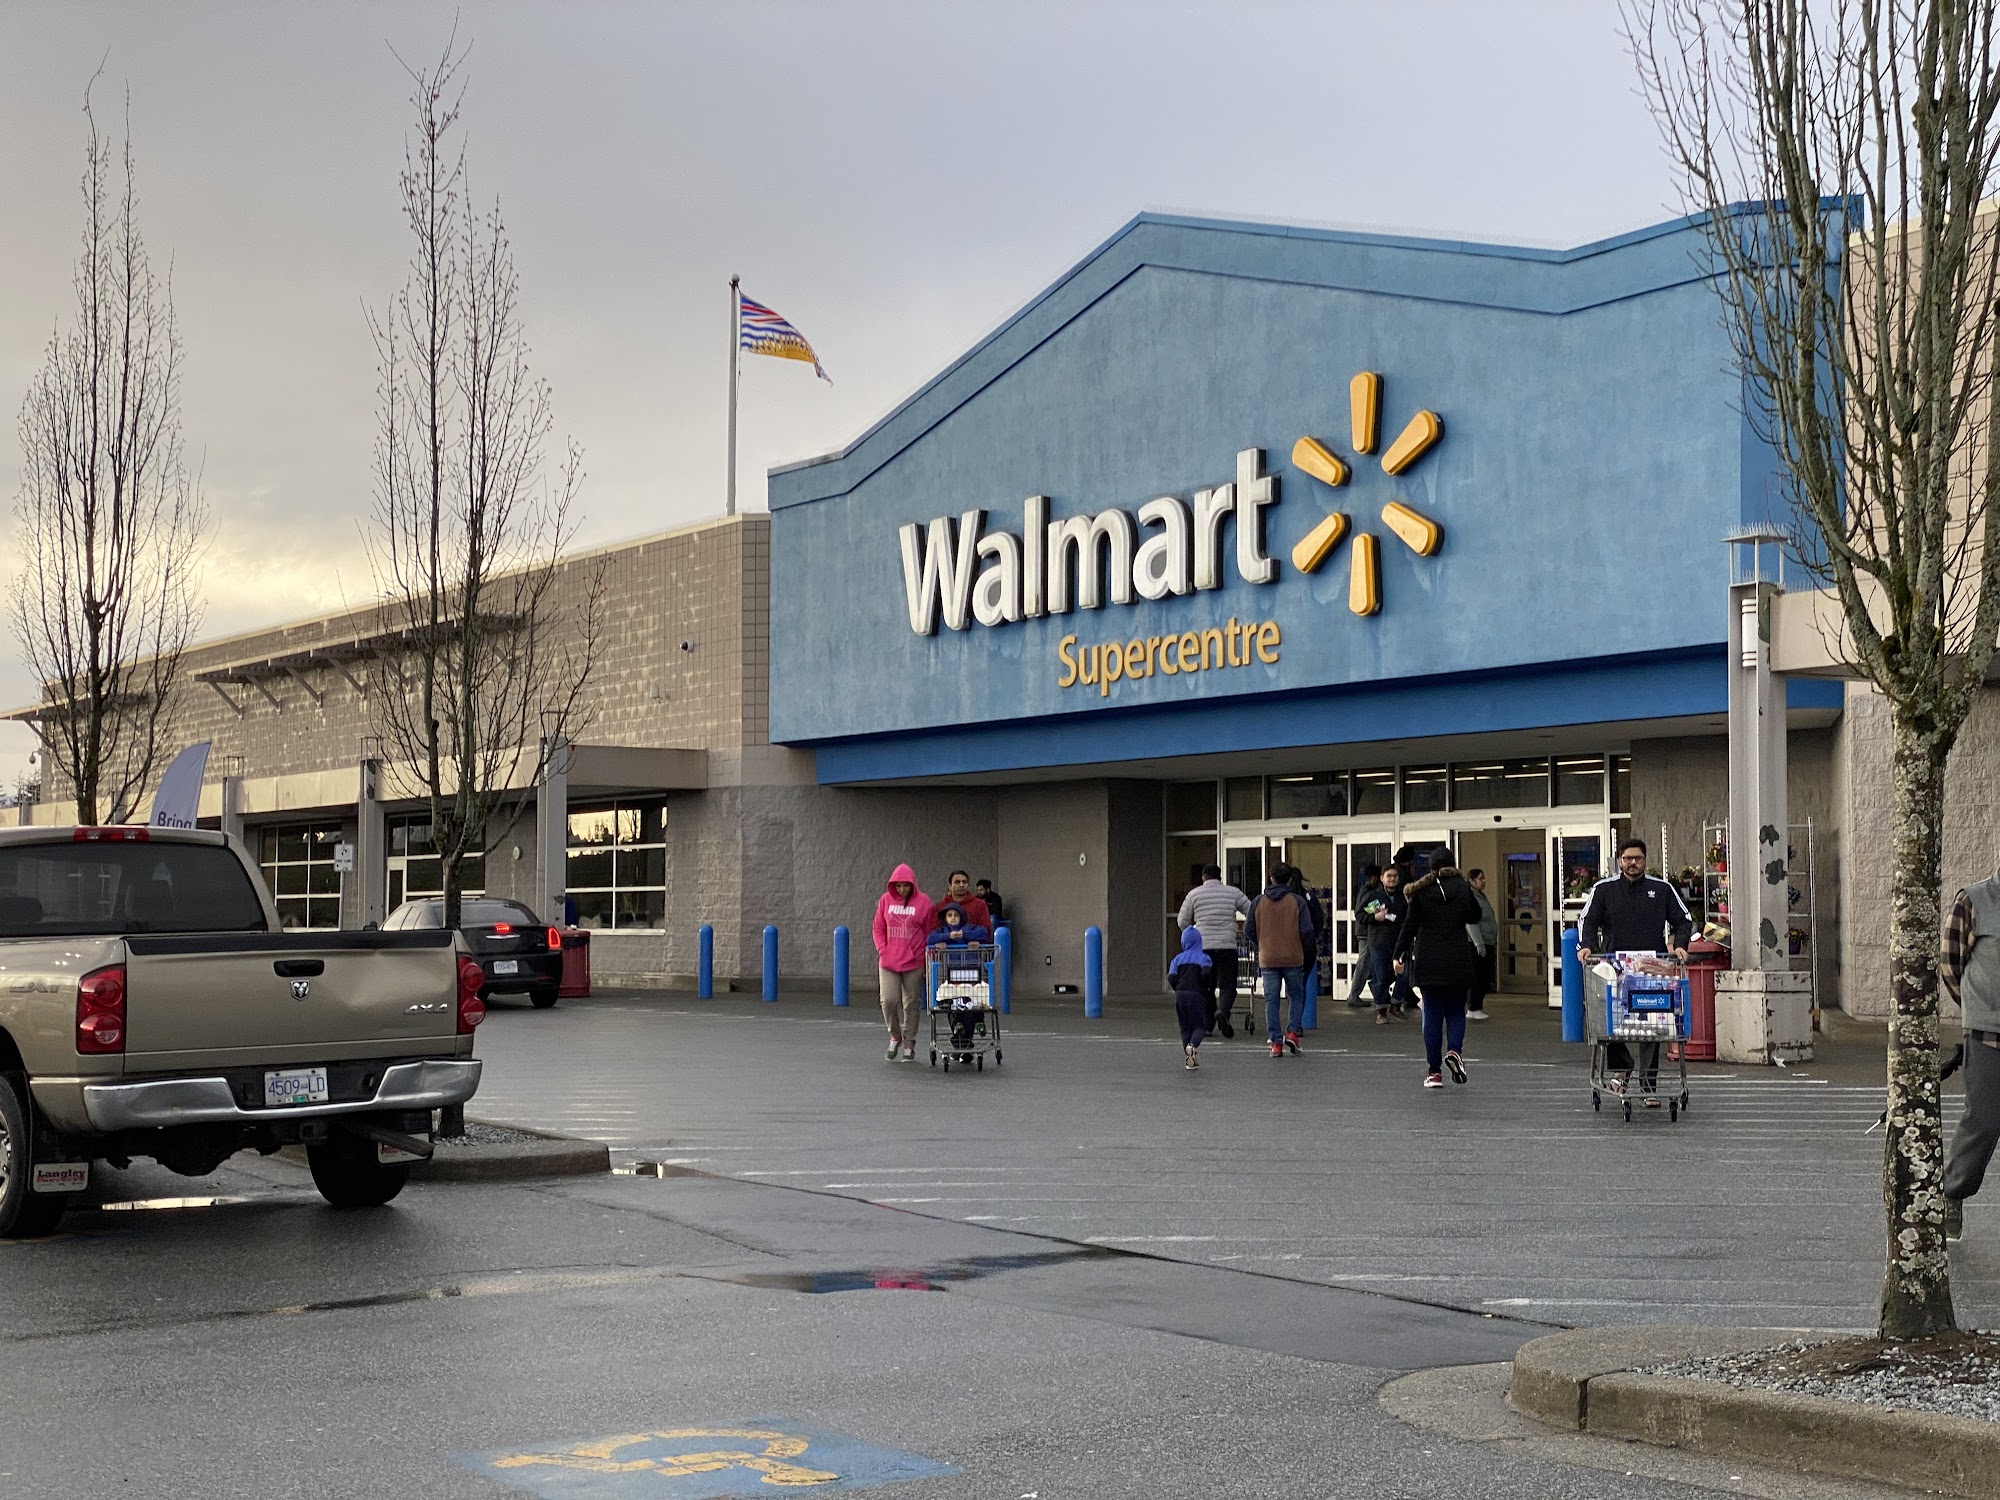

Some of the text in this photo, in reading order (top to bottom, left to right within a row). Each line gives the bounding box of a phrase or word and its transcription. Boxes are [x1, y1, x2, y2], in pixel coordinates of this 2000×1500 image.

[899, 447, 1281, 636] Walmart
[1058, 616, 1281, 697] Supercentre
[888, 905, 915, 916] PUMA
[37, 1169, 86, 1180] Langley
